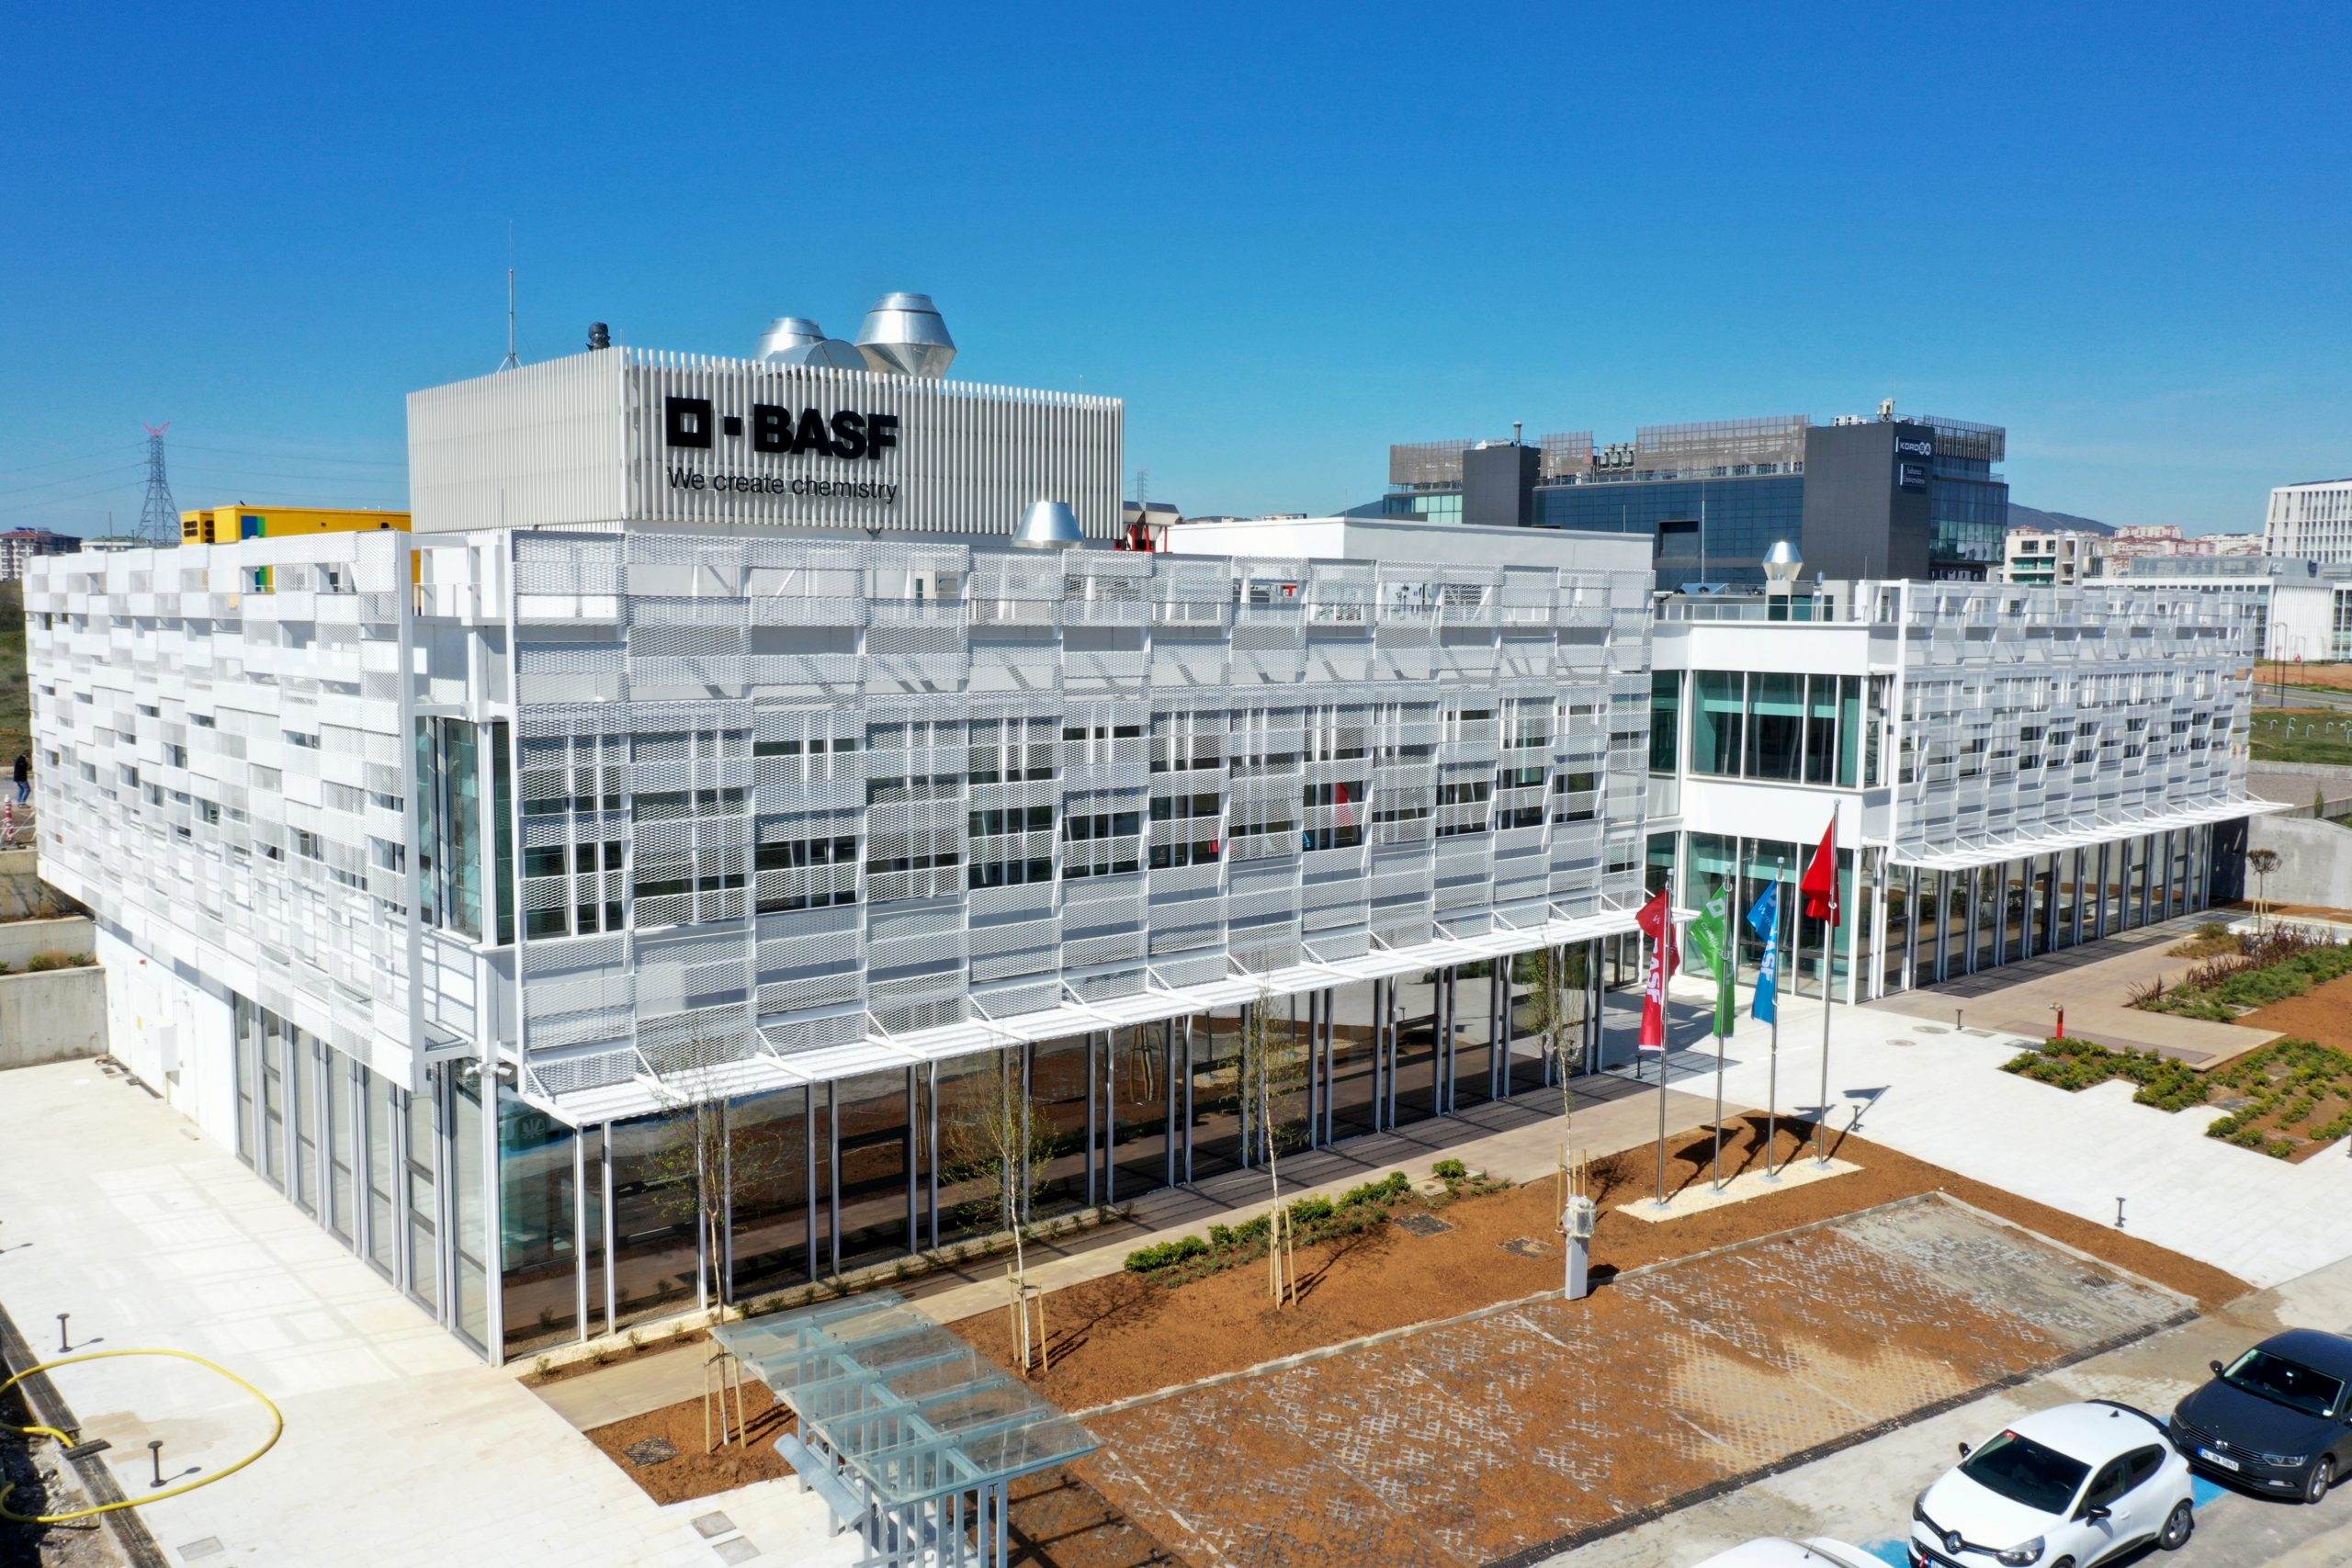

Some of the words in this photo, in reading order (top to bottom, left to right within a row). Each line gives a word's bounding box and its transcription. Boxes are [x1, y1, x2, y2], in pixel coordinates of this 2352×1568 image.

[753, 403, 898, 460] BASF
[1899, 441, 1931, 456] KORDSA
[667, 466, 706, 490] We
[713, 473, 785, 495] create
[791, 474, 898, 504] chemistry
